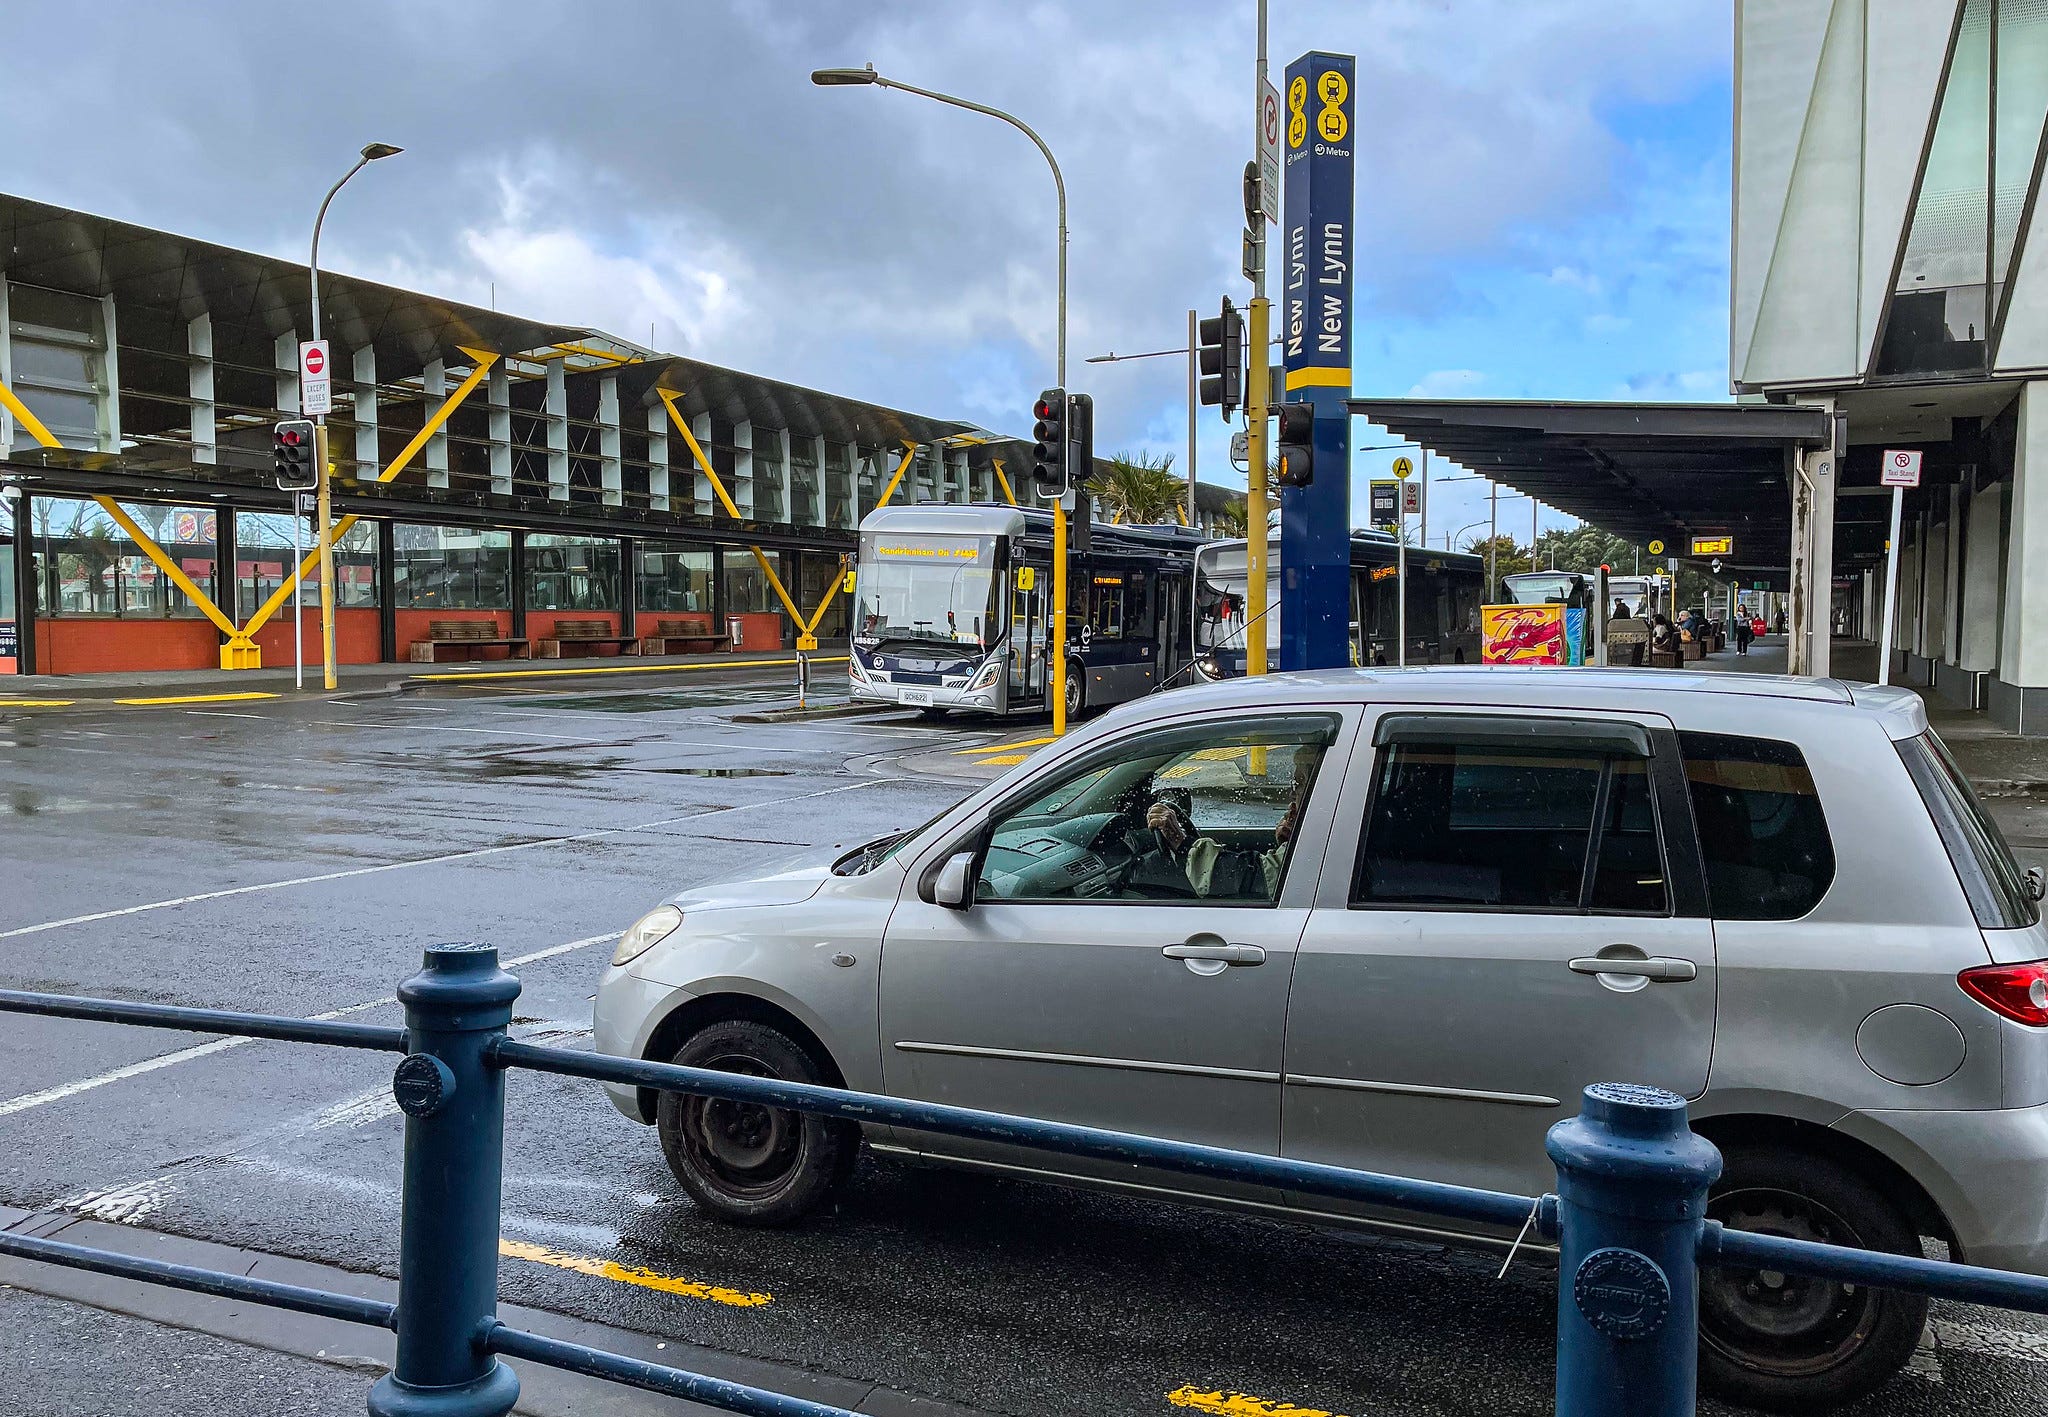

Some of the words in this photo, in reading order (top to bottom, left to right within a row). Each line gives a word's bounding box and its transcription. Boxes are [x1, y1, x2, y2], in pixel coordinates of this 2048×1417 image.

[1326, 146, 1350, 157] Metro
[1289, 225, 1306, 290] Lynn
[1319, 223, 1347, 285] Lynn
[1288, 299, 1303, 357] New
[1318, 294, 1342, 353] New
[306, 383, 326, 393] EXCEPT
[308, 393, 326, 402] BUSES
[1396, 459, 1409, 474] A
[1900, 469, 1915, 477] Stand
[1652, 543, 1660, 551] A
